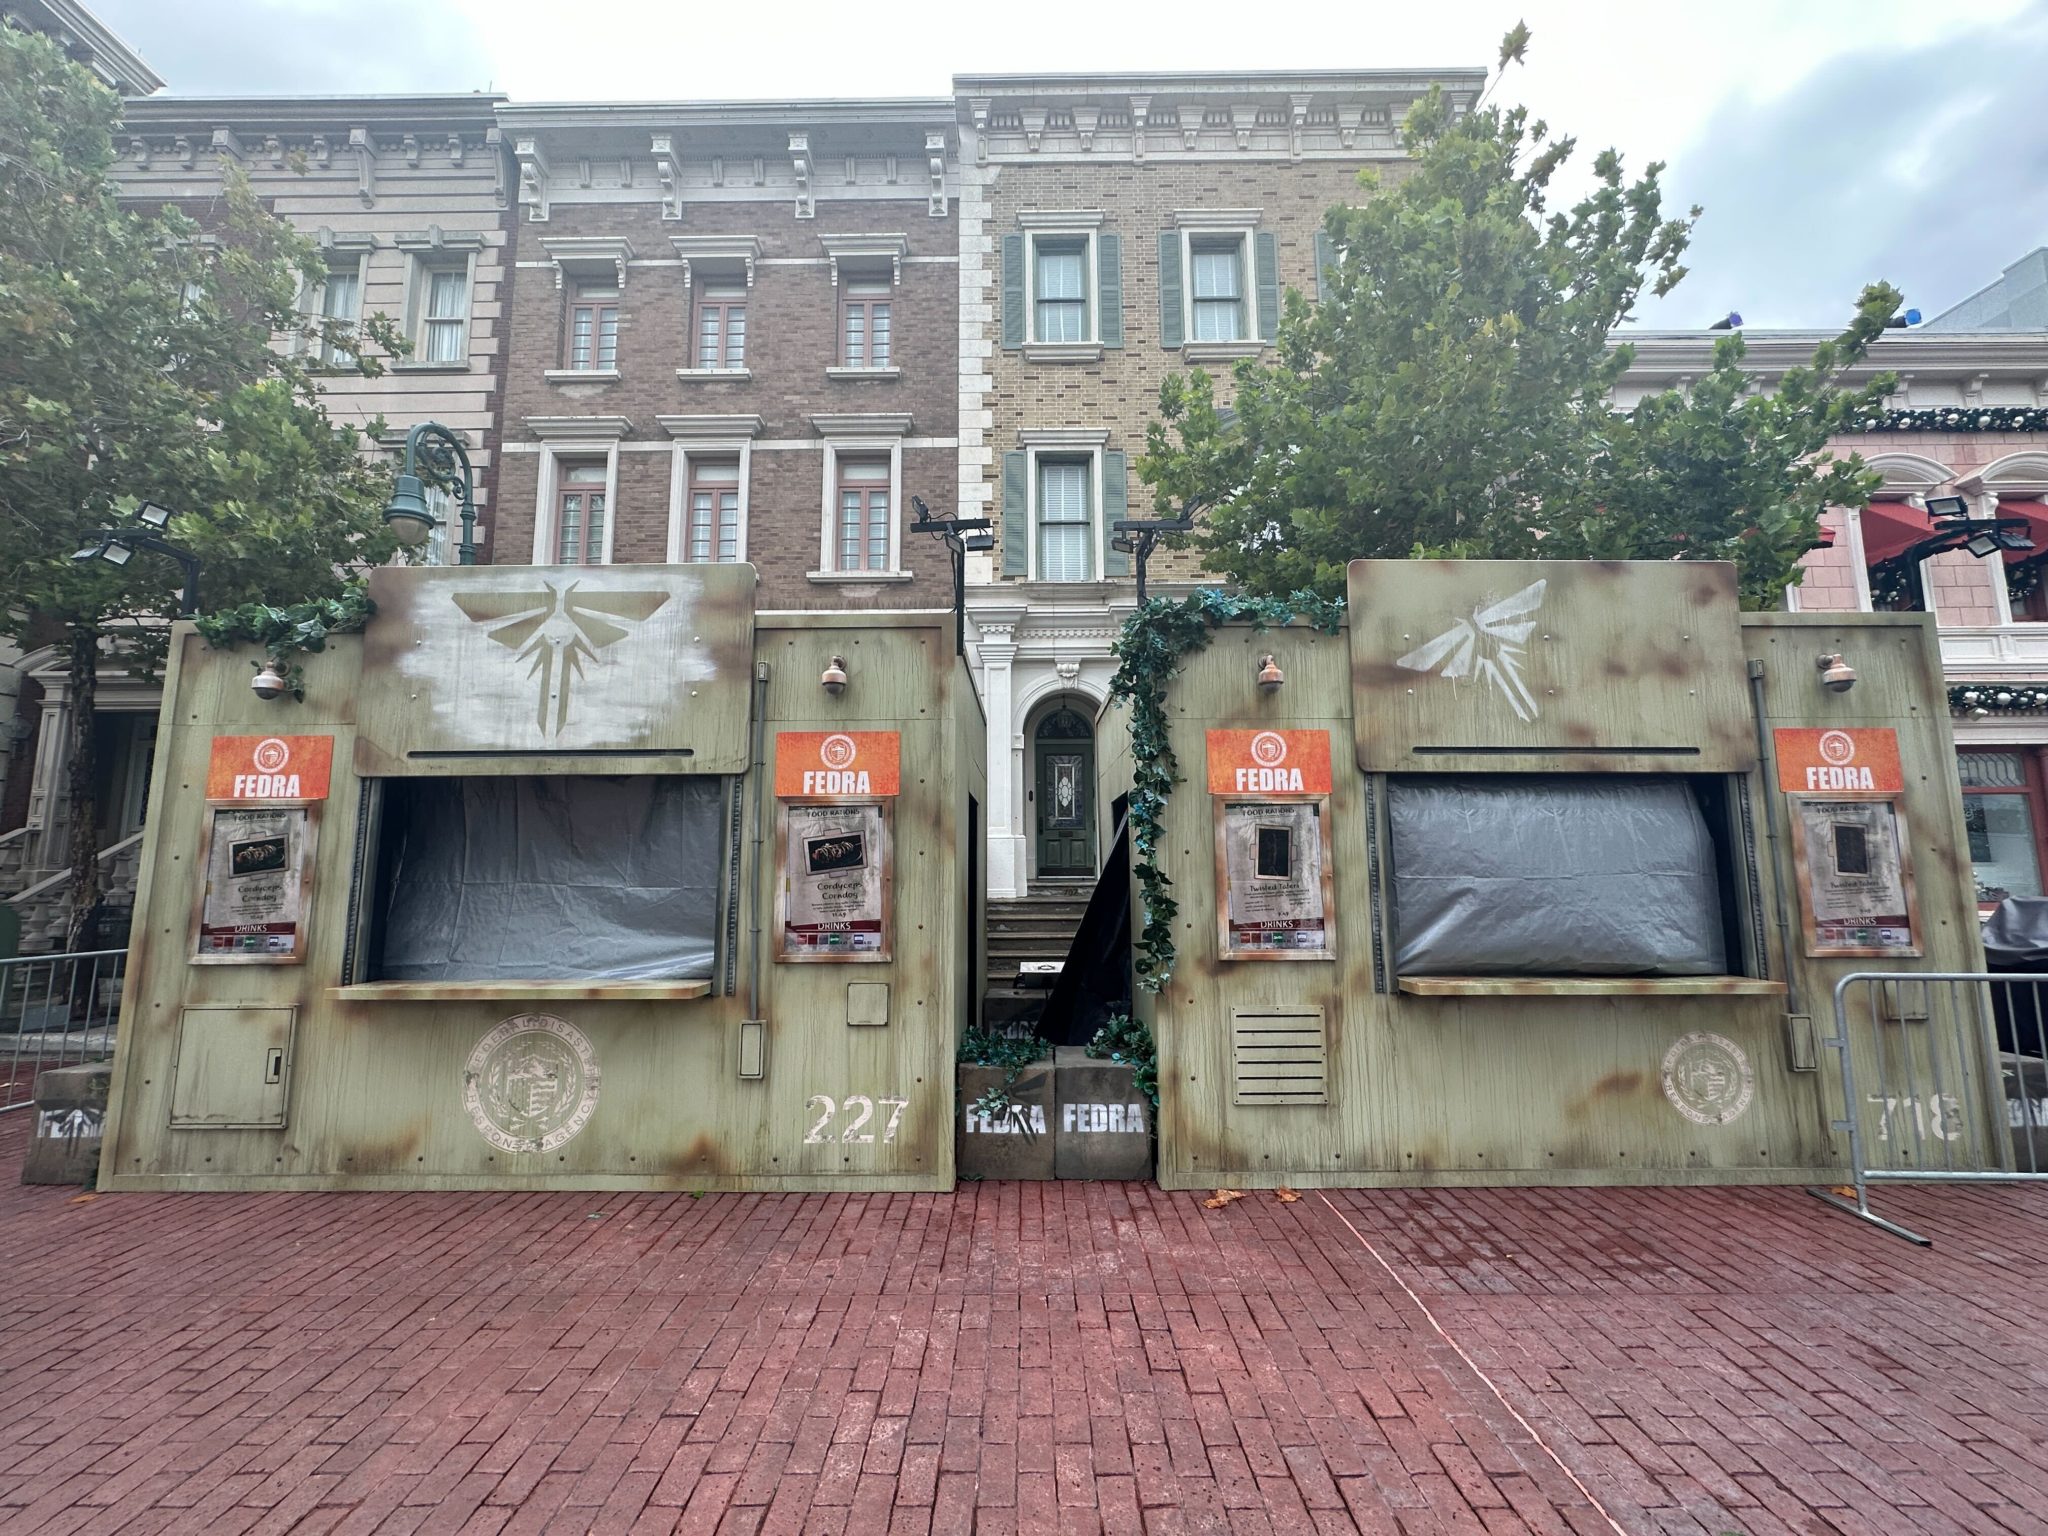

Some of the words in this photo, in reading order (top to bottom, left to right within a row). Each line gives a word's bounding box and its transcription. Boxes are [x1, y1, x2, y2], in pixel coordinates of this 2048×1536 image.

[233, 774, 300, 798] FEDRA
[803, 770, 871, 794] FEDRA
[1235, 768, 1304, 791] FEDRA
[1806, 766, 1875, 790] FEDRA
[817, 881, 863, 891] Cordyceps
[1250, 882, 1277, 892] Twisted
[822, 891, 858, 900] Corndog
[817, 920, 851, 930] DRINKS
[1260, 919, 1294, 929] DRINKS
[1843, 915, 1877, 926] DRINKS
[803, 1095, 910, 1144] 227
[1063, 1103, 1145, 1134] FEDRA
